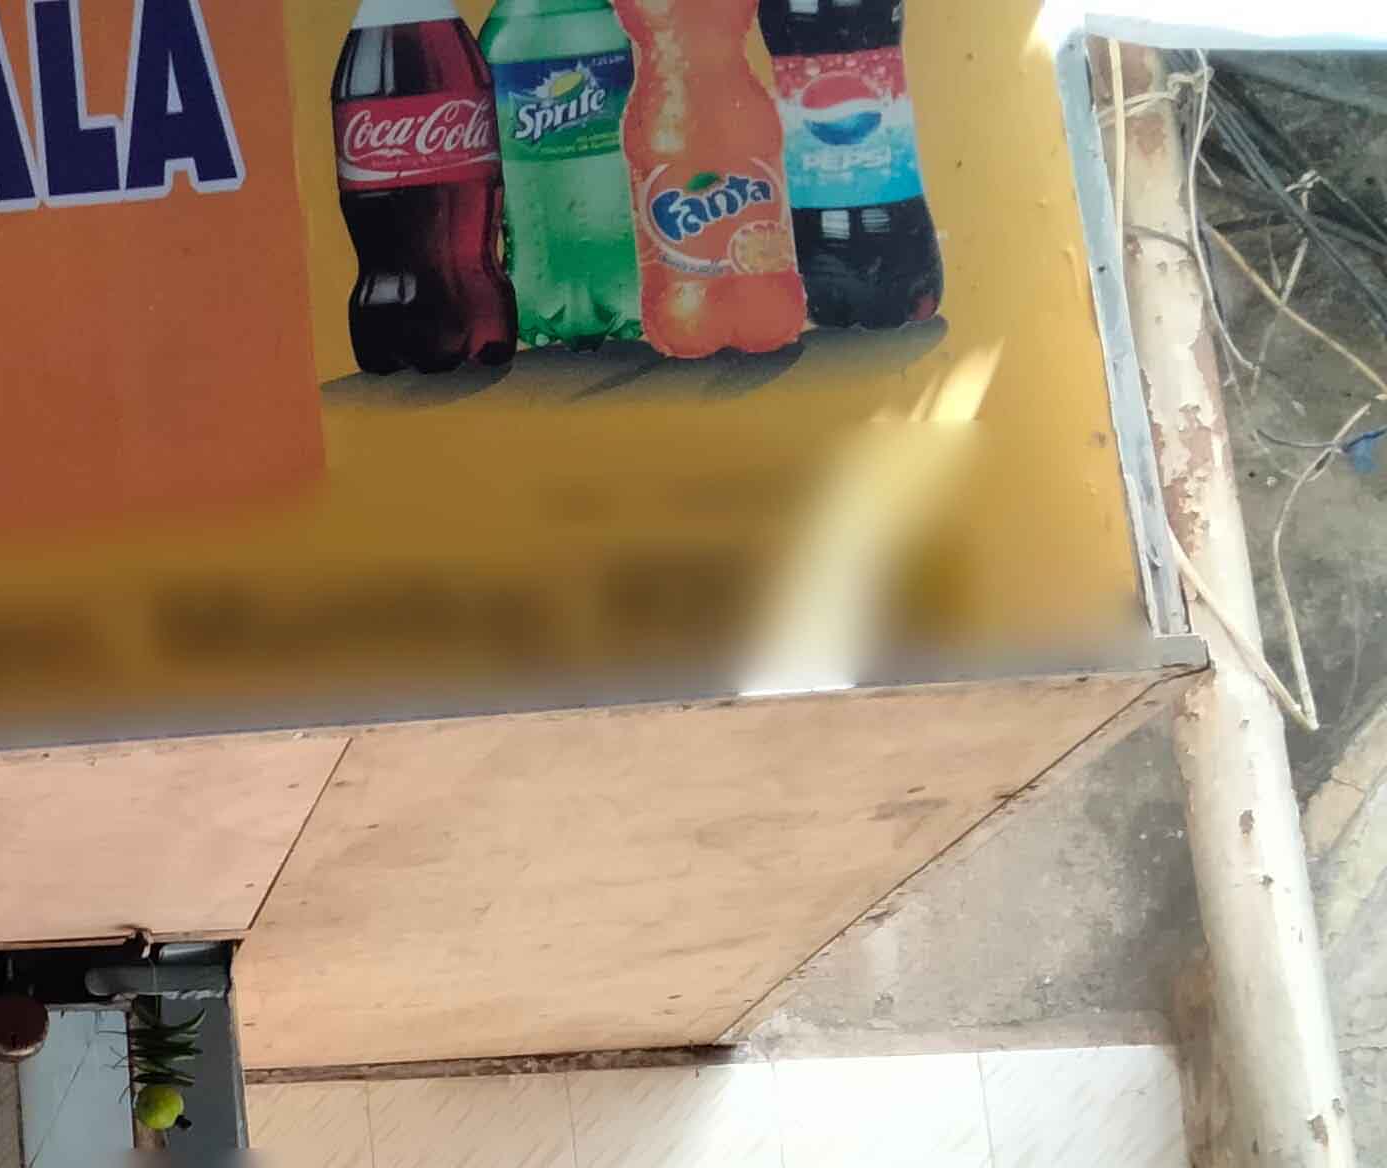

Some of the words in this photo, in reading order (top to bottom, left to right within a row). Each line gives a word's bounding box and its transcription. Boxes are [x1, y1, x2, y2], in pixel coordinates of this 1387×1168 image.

[343, 99, 491, 161] Coca-Cola
[515, 86, 606, 141] Sprite
[651, 175, 772, 242] Fanta
